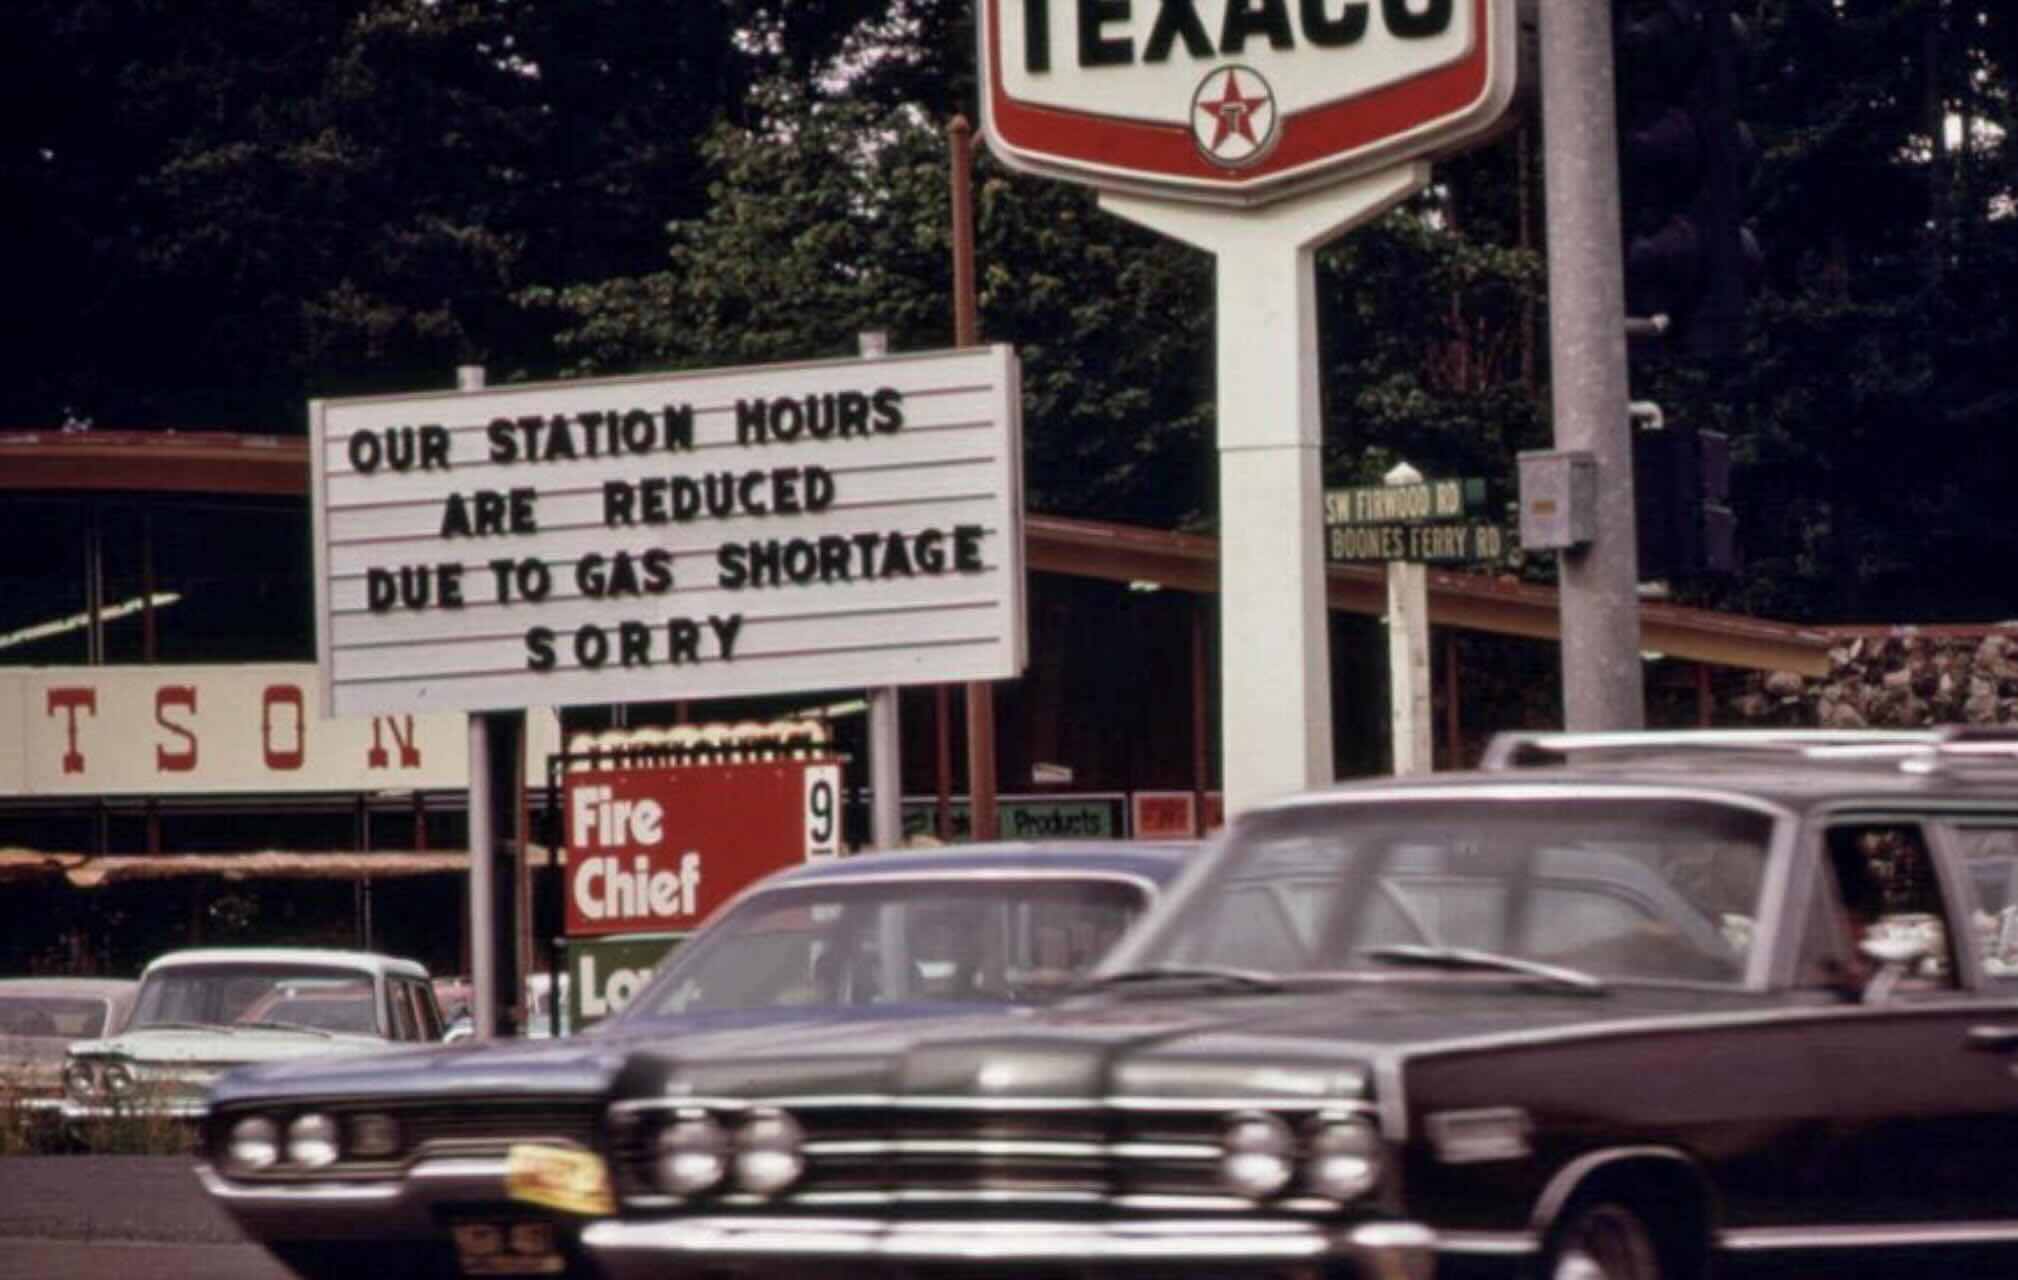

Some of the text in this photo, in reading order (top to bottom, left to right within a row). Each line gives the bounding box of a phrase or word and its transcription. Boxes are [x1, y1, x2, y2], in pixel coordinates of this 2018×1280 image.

[350, 390, 901, 473] OUR STATION HOURS
[441, 468, 833, 538] ARE REDUCED
[1326, 492, 1350, 524] SW
[1436, 481, 1461, 515] RD
[368, 527, 982, 613] DUE TO GAS SHORTAGE
[1331, 525, 1501, 559] BOONES FERRY RD
[526, 616, 741, 671] SORRY
[572, 786, 664, 848] Fire
[811, 779, 833, 845] 9
[1014, 808, 1101, 835] Products
[574, 852, 700, 920] Chief
[579, 954, 652, 1018] Lo
